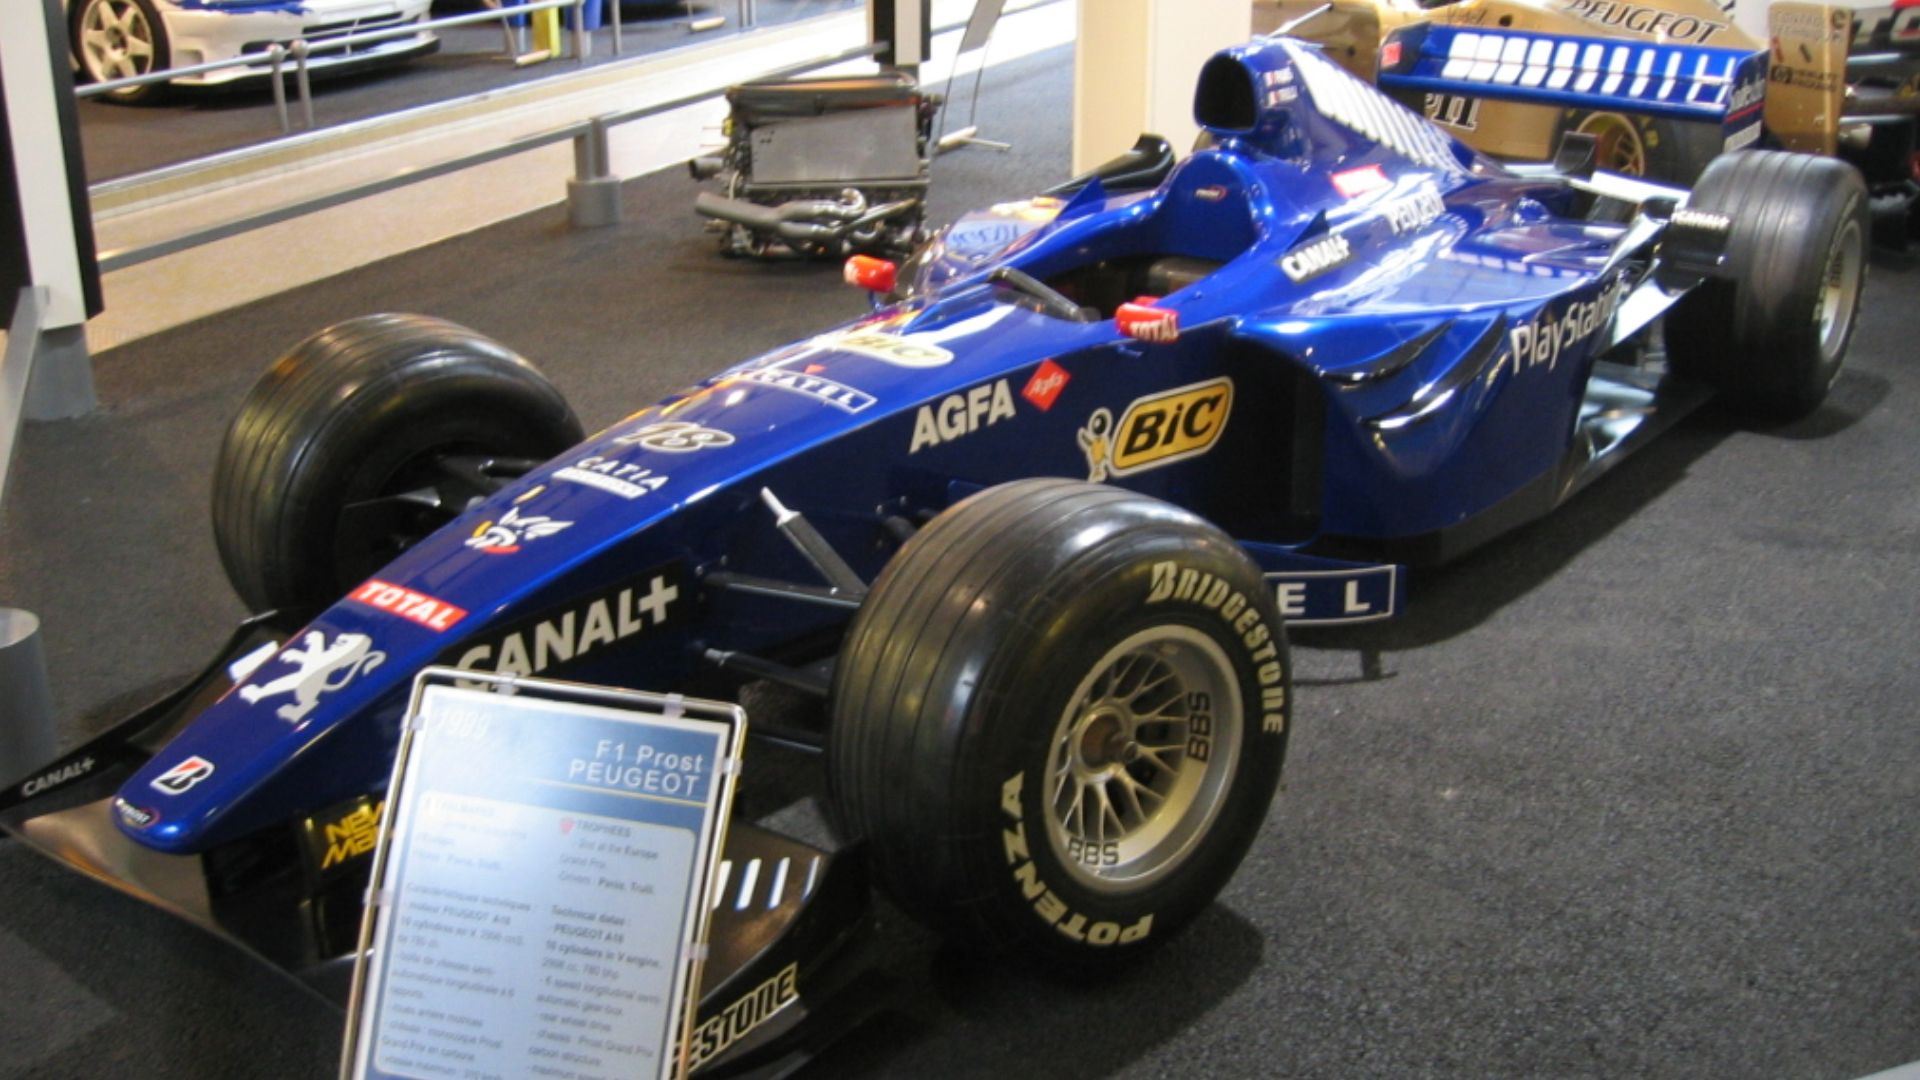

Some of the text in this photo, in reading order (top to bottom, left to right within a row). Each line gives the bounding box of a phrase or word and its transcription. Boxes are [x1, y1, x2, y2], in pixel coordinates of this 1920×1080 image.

[1130, 312, 1180, 343] TOTAL
[909, 379, 1016, 454] AGFA
[576, 455, 670, 492] CATIA
[360, 580, 459, 628] TOTAL
[455, 575, 680, 694] CANAL+
[1145, 560, 1286, 736] BRIDGESTONE
[1187, 691, 1211, 763] BBS
[596, 739, 705, 774] F1 Prost
[22, 757, 95, 797] CANAL+
[568, 758, 702, 797] PEUGEOT
[1001, 770, 1155, 947] POTENZA
[1067, 836, 1120, 867] BBS
[554, 923, 603, 940] PEUGEOT
